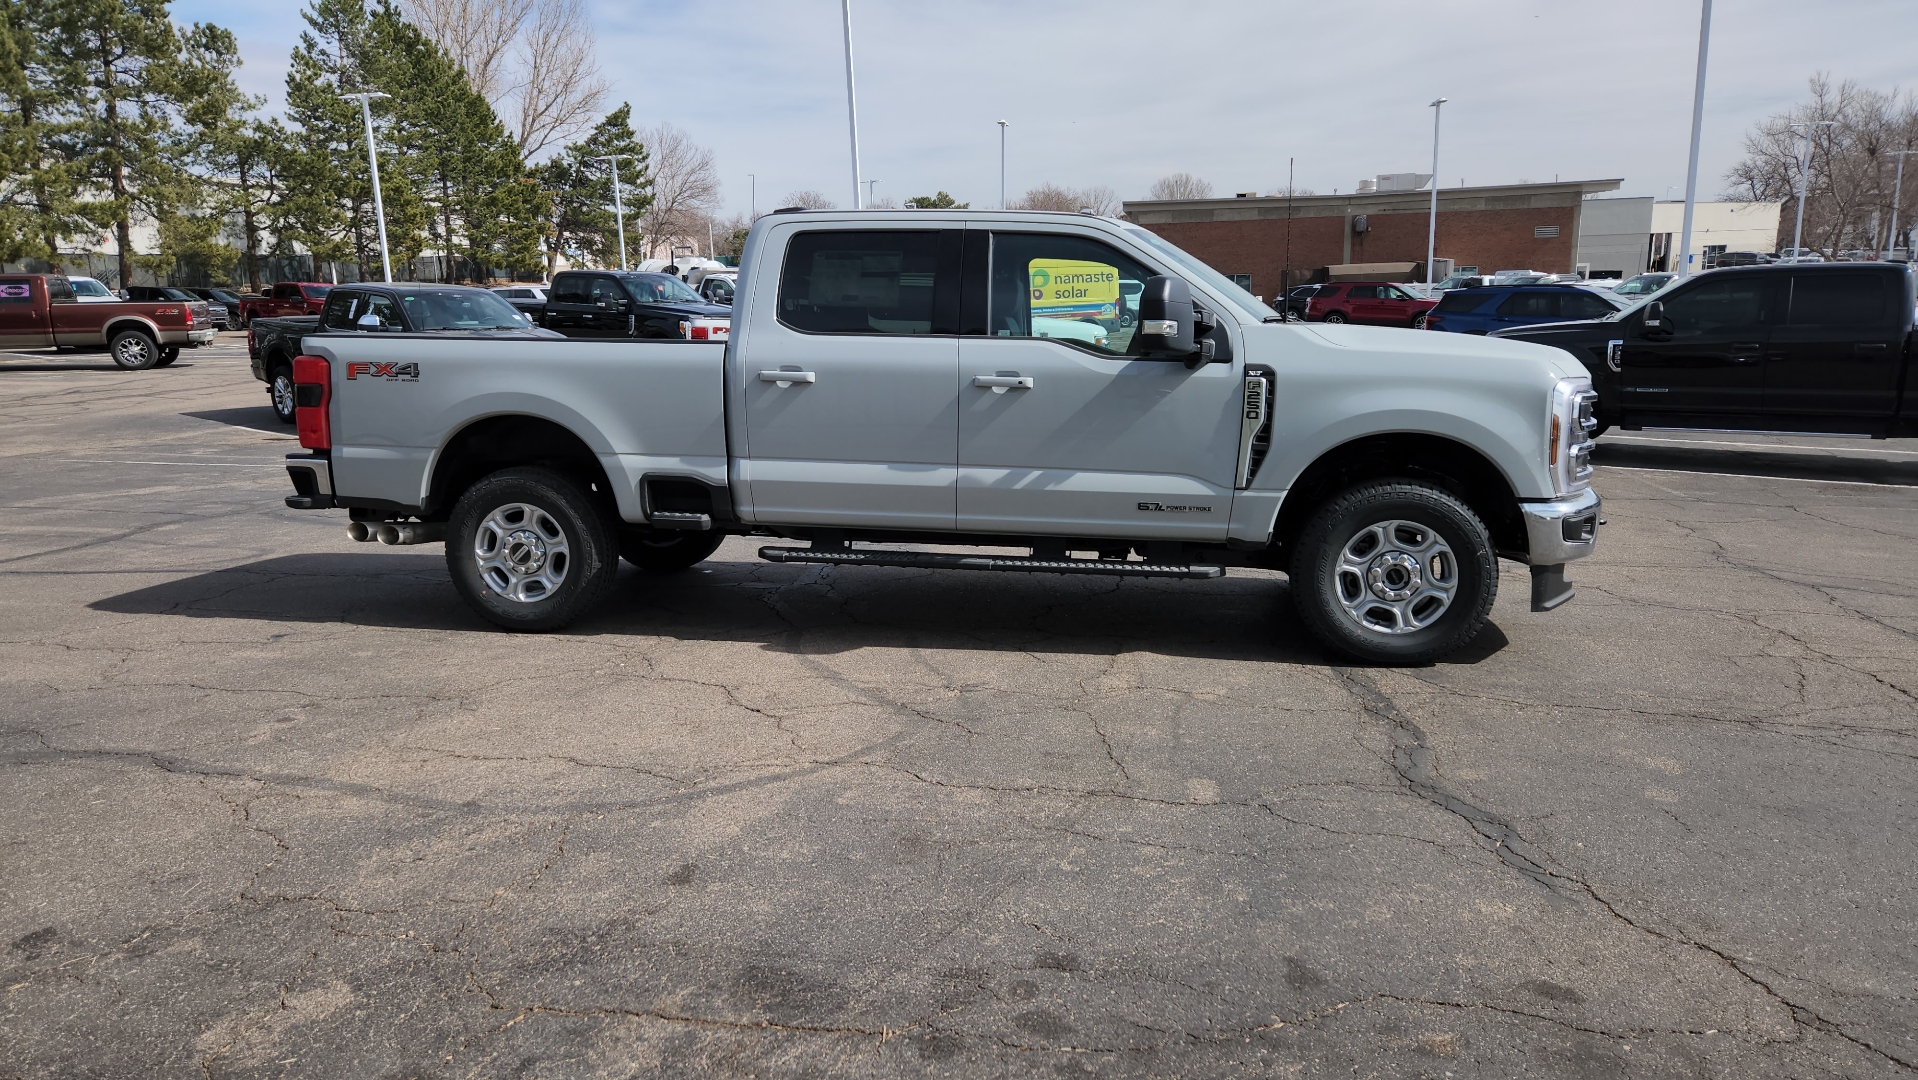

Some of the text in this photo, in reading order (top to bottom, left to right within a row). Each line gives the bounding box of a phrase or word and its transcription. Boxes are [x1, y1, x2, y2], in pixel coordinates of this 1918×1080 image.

[1054, 271, 1114, 285] namaste
[1055, 286, 1089, 299] solar
[346, 361, 420, 380] FX4
[1245, 381, 1261, 420] F250
